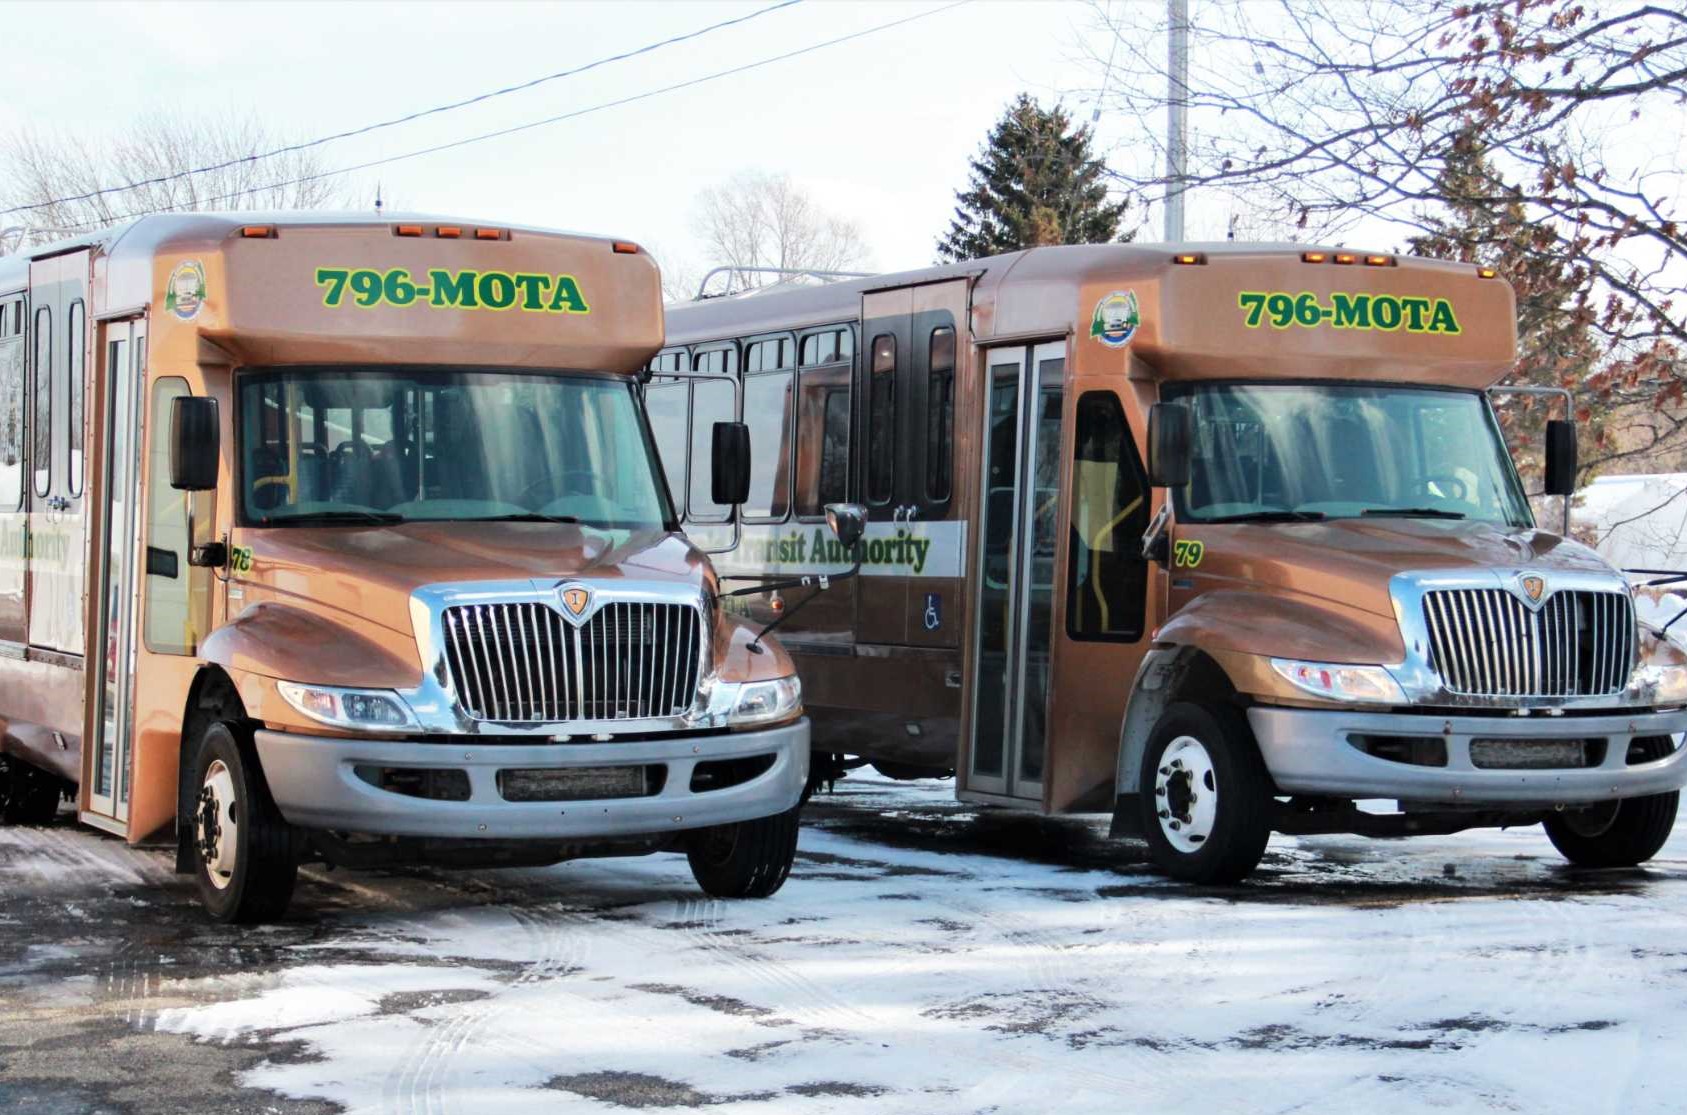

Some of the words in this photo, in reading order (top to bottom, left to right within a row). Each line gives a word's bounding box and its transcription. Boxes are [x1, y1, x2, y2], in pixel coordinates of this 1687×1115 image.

[314, 266, 590, 314] 796-MOTA
[1238, 291, 1462, 335] 796-MOTA
[231, 545, 254, 575] 78
[1174, 539, 1205, 568] 79
